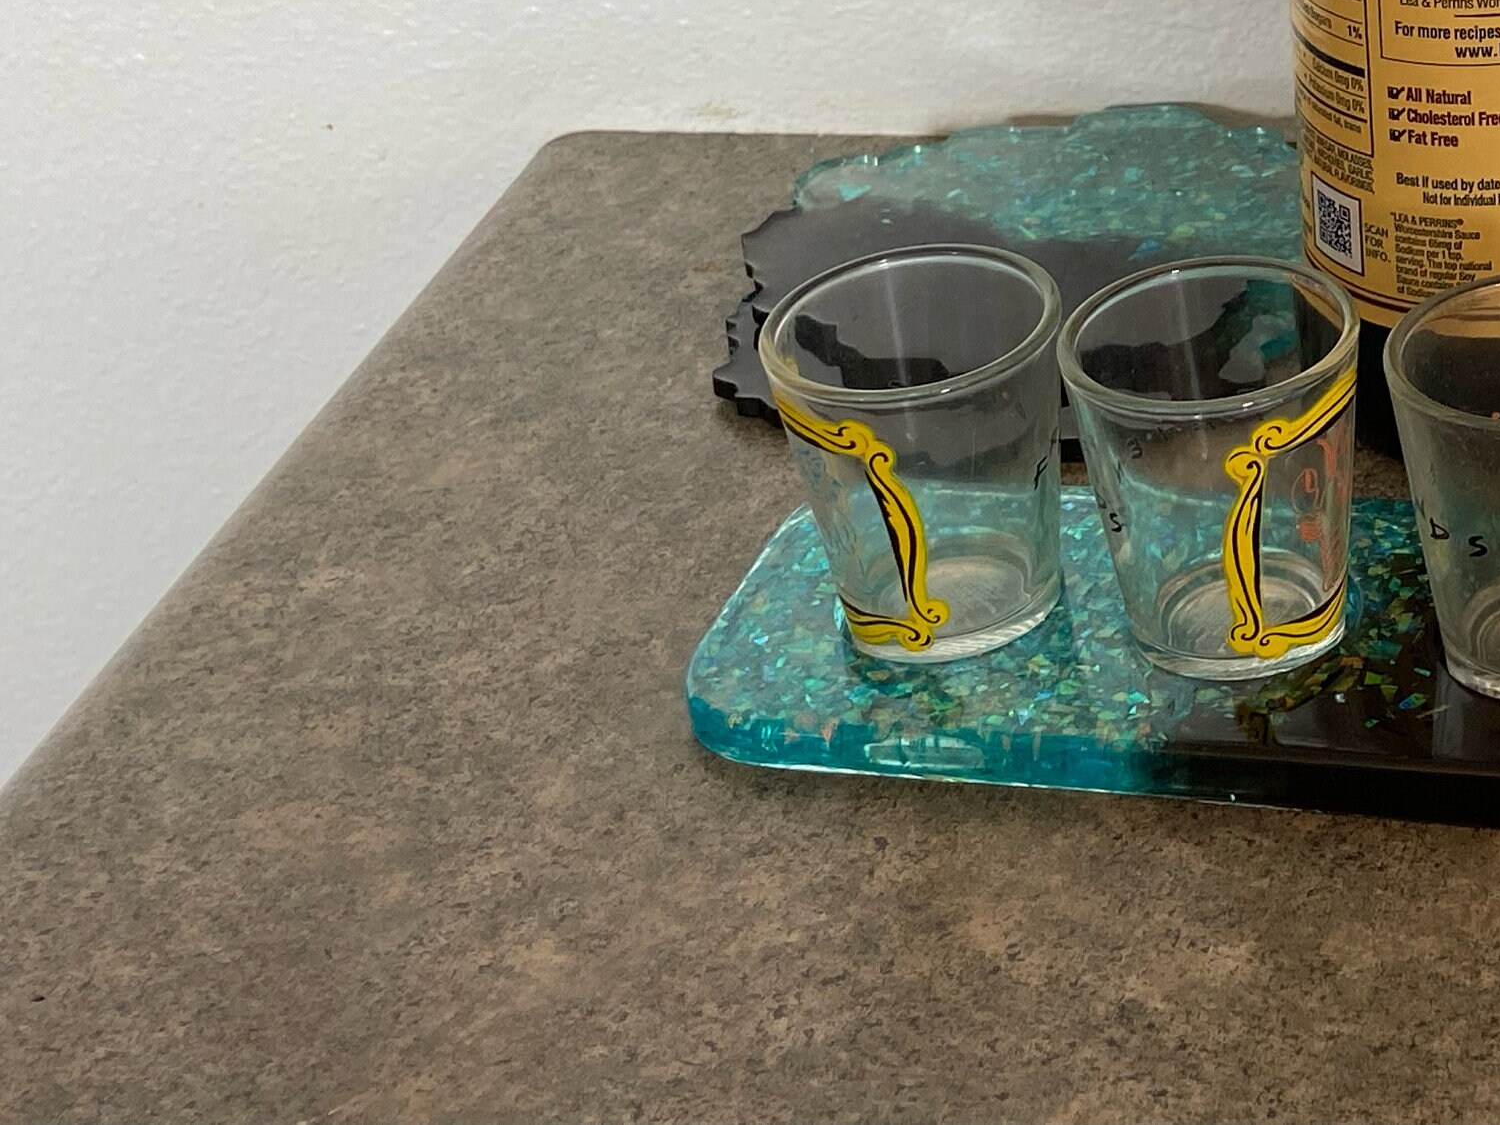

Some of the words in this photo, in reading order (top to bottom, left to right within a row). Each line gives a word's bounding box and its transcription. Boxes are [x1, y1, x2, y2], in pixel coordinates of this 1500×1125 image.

[1347, 24, 1362, 40] 1%
[1394, 20, 1415, 37] For
[1417, 25, 1451, 40] more
[1406, 86, 1423, 102] All
[1426, 88, 1472, 105] Natural
[1406, 107, 1475, 126] Cholesterol
[1407, 129, 1428, 146] Fat
[1431, 131, 1459, 147] Free
[1396, 172, 1420, 187] Best
[1431, 177, 1458, 190] used
[1460, 179, 1475, 193] by
[1477, 178, 1500, 190] date
[1423, 191, 1438, 205] Not
[1440, 192, 1452, 205] for
[1454, 193, 1496, 206] Individual
[1364, 222, 1389, 237] SCAN
[1454, 230, 1480, 240] Sauce
[1365, 235, 1384, 249] FOR
[1365, 249, 1391, 263] INFO.
[1468, 535, 1488, 557] S
